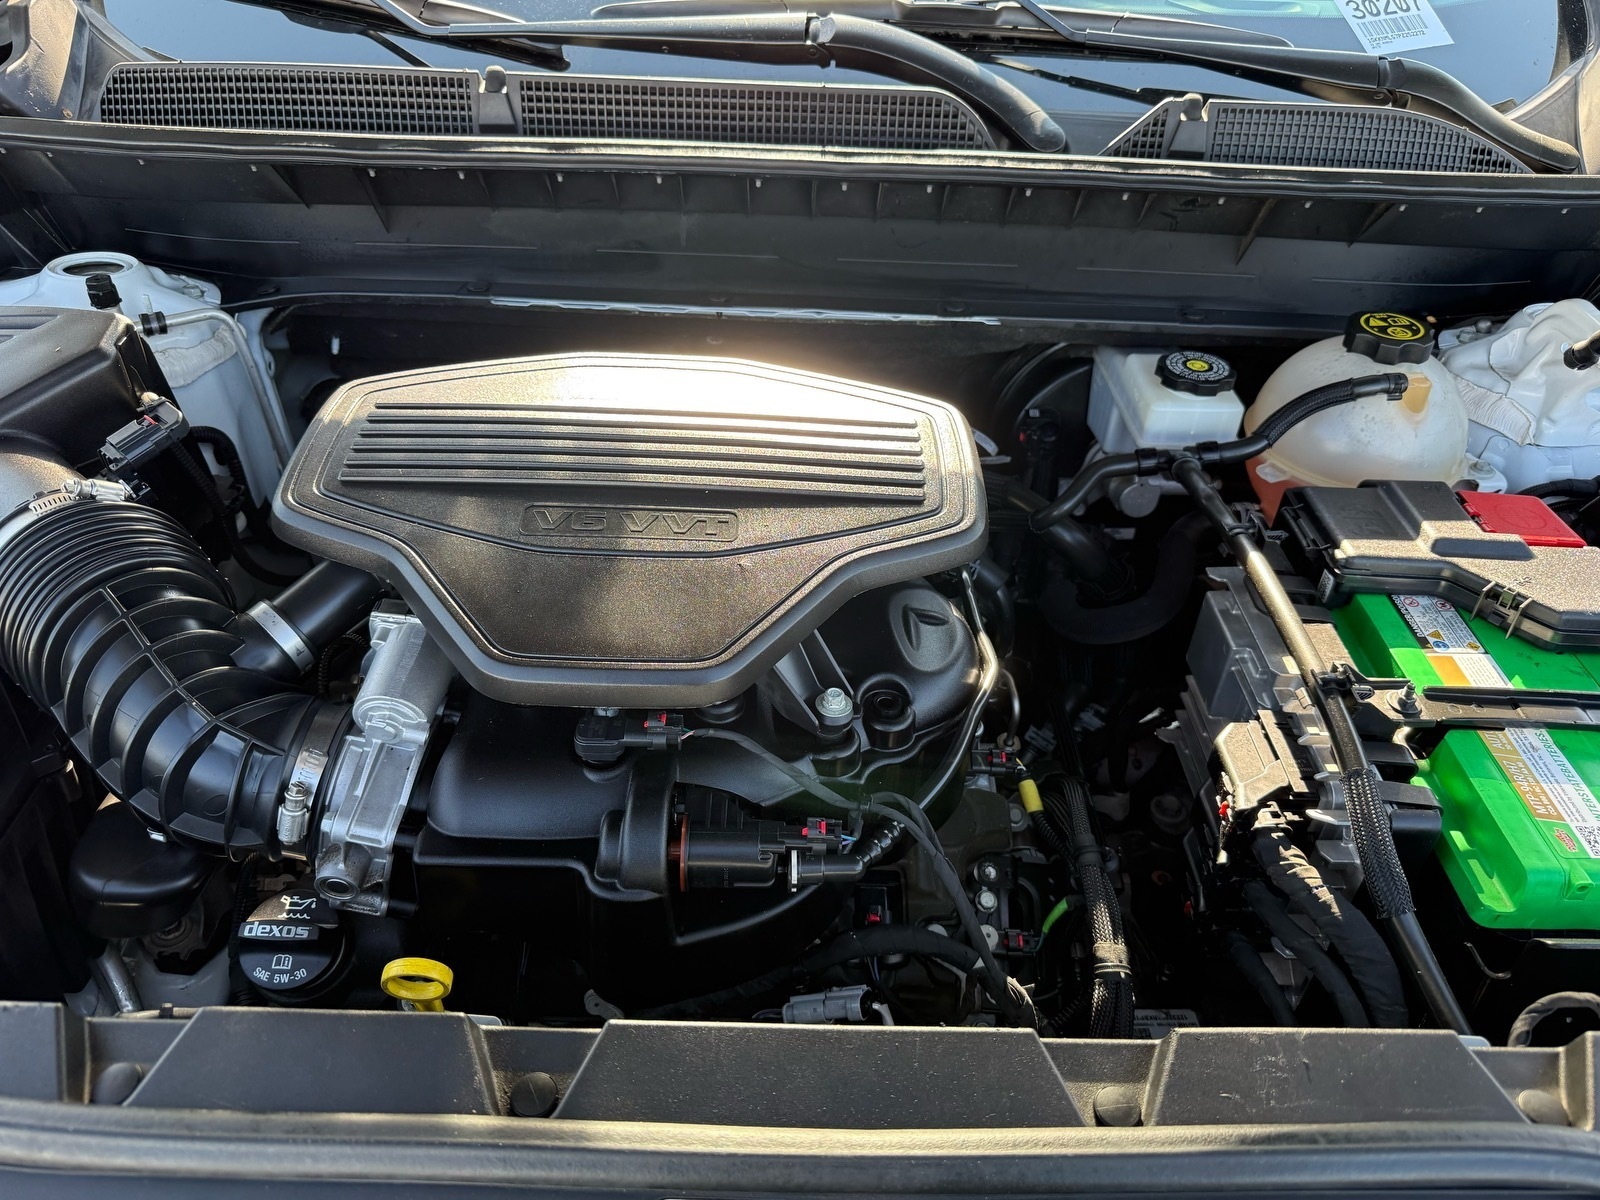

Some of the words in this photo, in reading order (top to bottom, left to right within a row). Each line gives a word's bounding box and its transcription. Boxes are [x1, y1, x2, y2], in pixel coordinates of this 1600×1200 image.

[532, 509, 607, 531] V6
[620, 511, 730, 536] VVT
[1502, 760, 1549, 815] MTP-94R/H7
[243, 921, 310, 938] dexos
[253, 966, 271, 982] SAE
[273, 968, 307, 984] 5W-30
